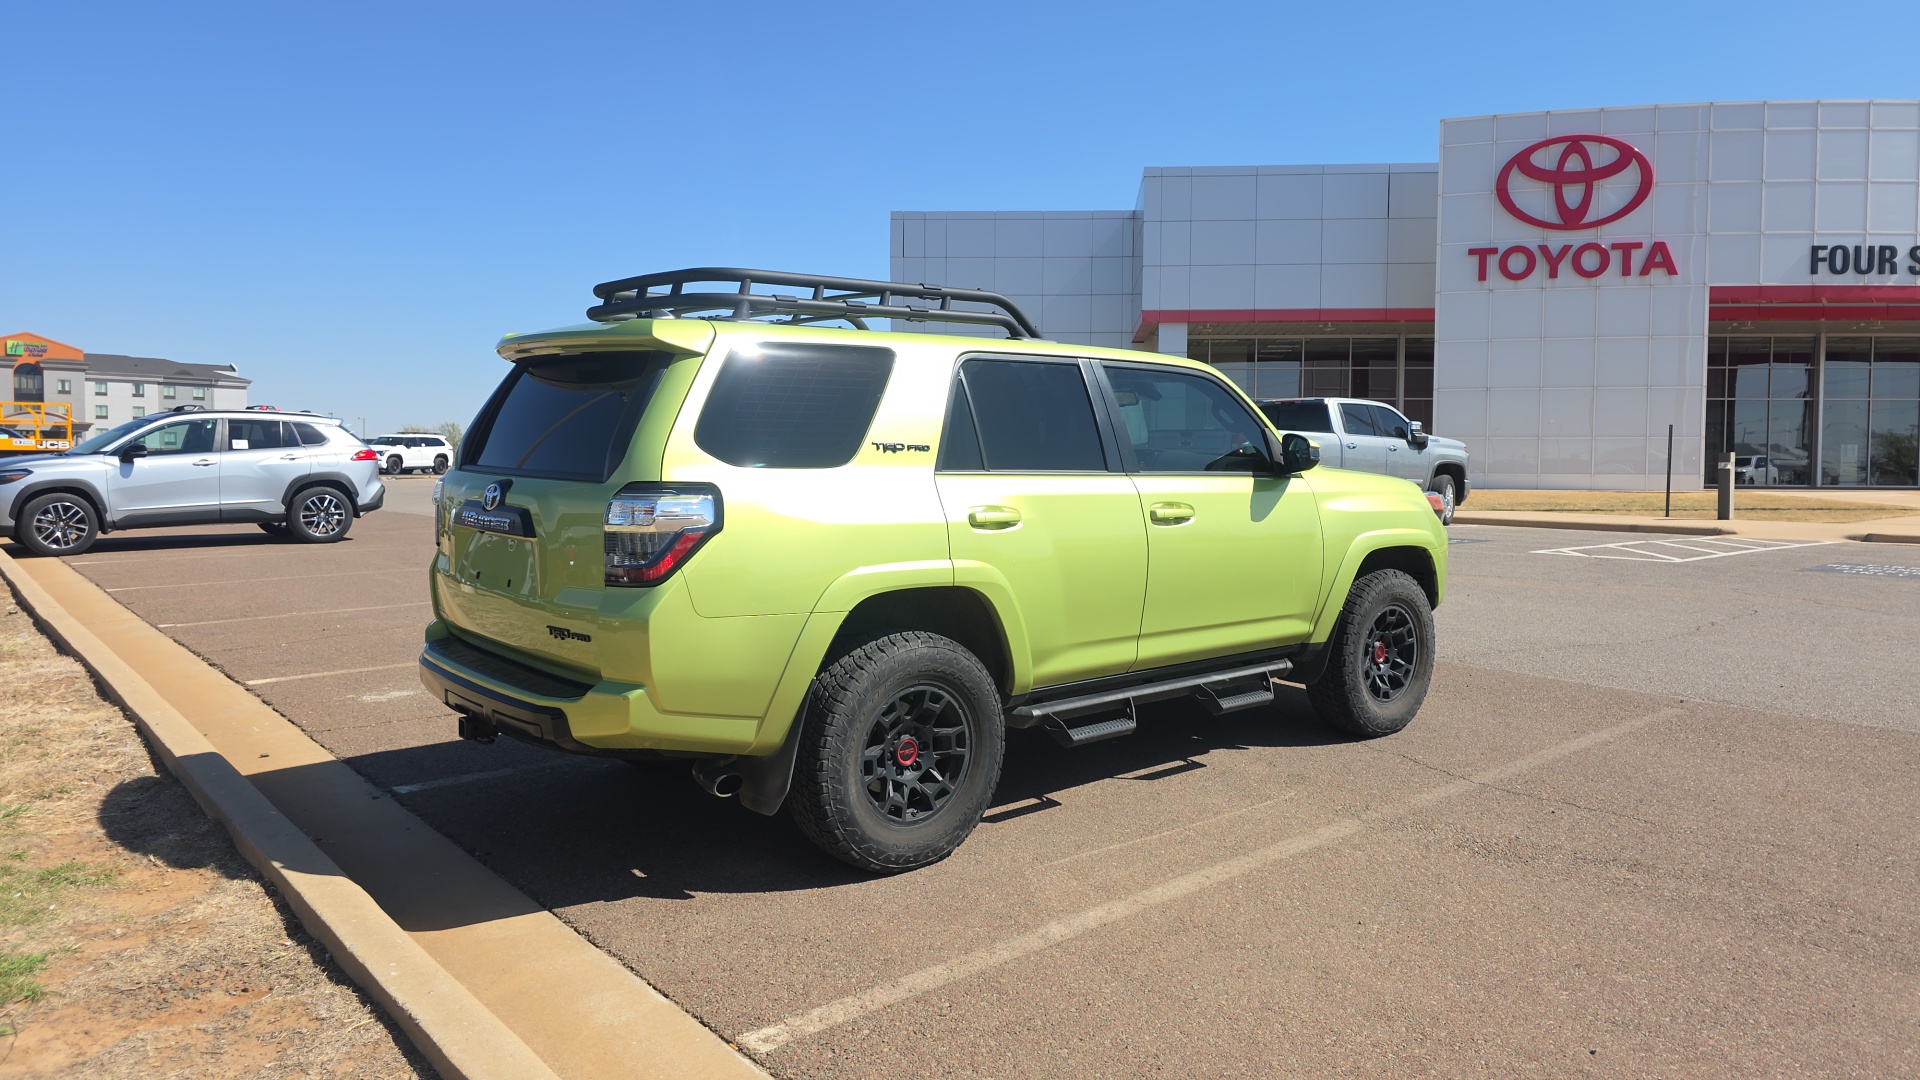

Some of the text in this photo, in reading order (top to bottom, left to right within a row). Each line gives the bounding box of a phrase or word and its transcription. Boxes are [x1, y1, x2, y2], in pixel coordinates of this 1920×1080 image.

[1468, 241, 1679, 282] TOYOTA
[1810, 245, 1898, 275] FOUR
[36, 440, 70, 449] JCB
[872, 442, 905, 454] TRD
[546, 625, 571, 640] TRD
